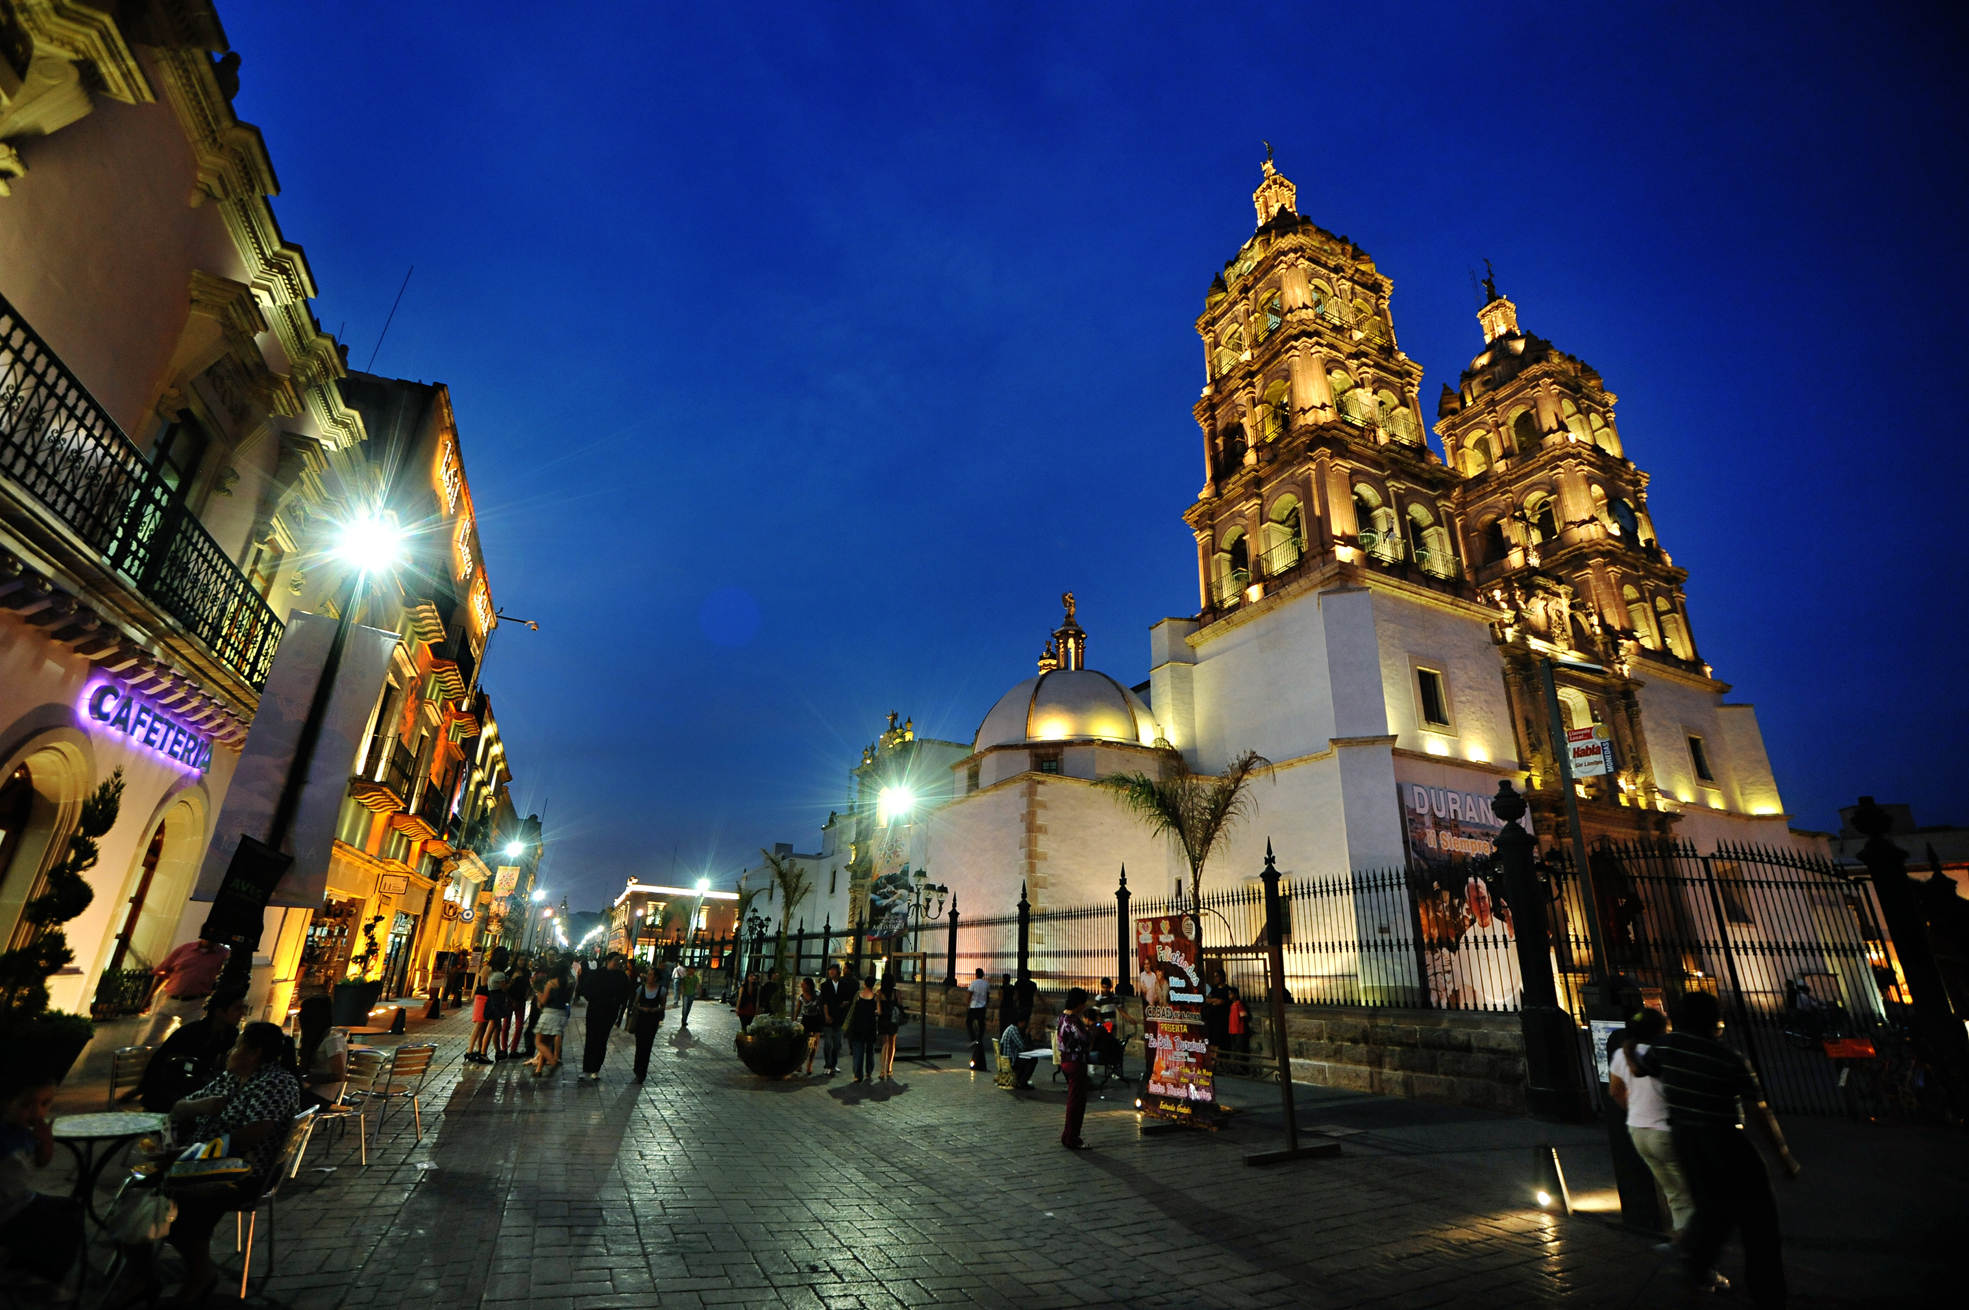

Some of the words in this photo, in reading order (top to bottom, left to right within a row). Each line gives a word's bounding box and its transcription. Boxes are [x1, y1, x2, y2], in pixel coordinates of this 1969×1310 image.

[89, 684, 214, 774] CAFETERIA
[1573, 744, 1602, 758] Habla
[1603, 742, 1614, 772] MONEDAS
[1412, 785, 1526, 828] DURAN
[1440, 831, 1490, 857] Siempre
[229, 877, 264, 900] AVES
[1156, 945, 1200, 986] Felicidades
